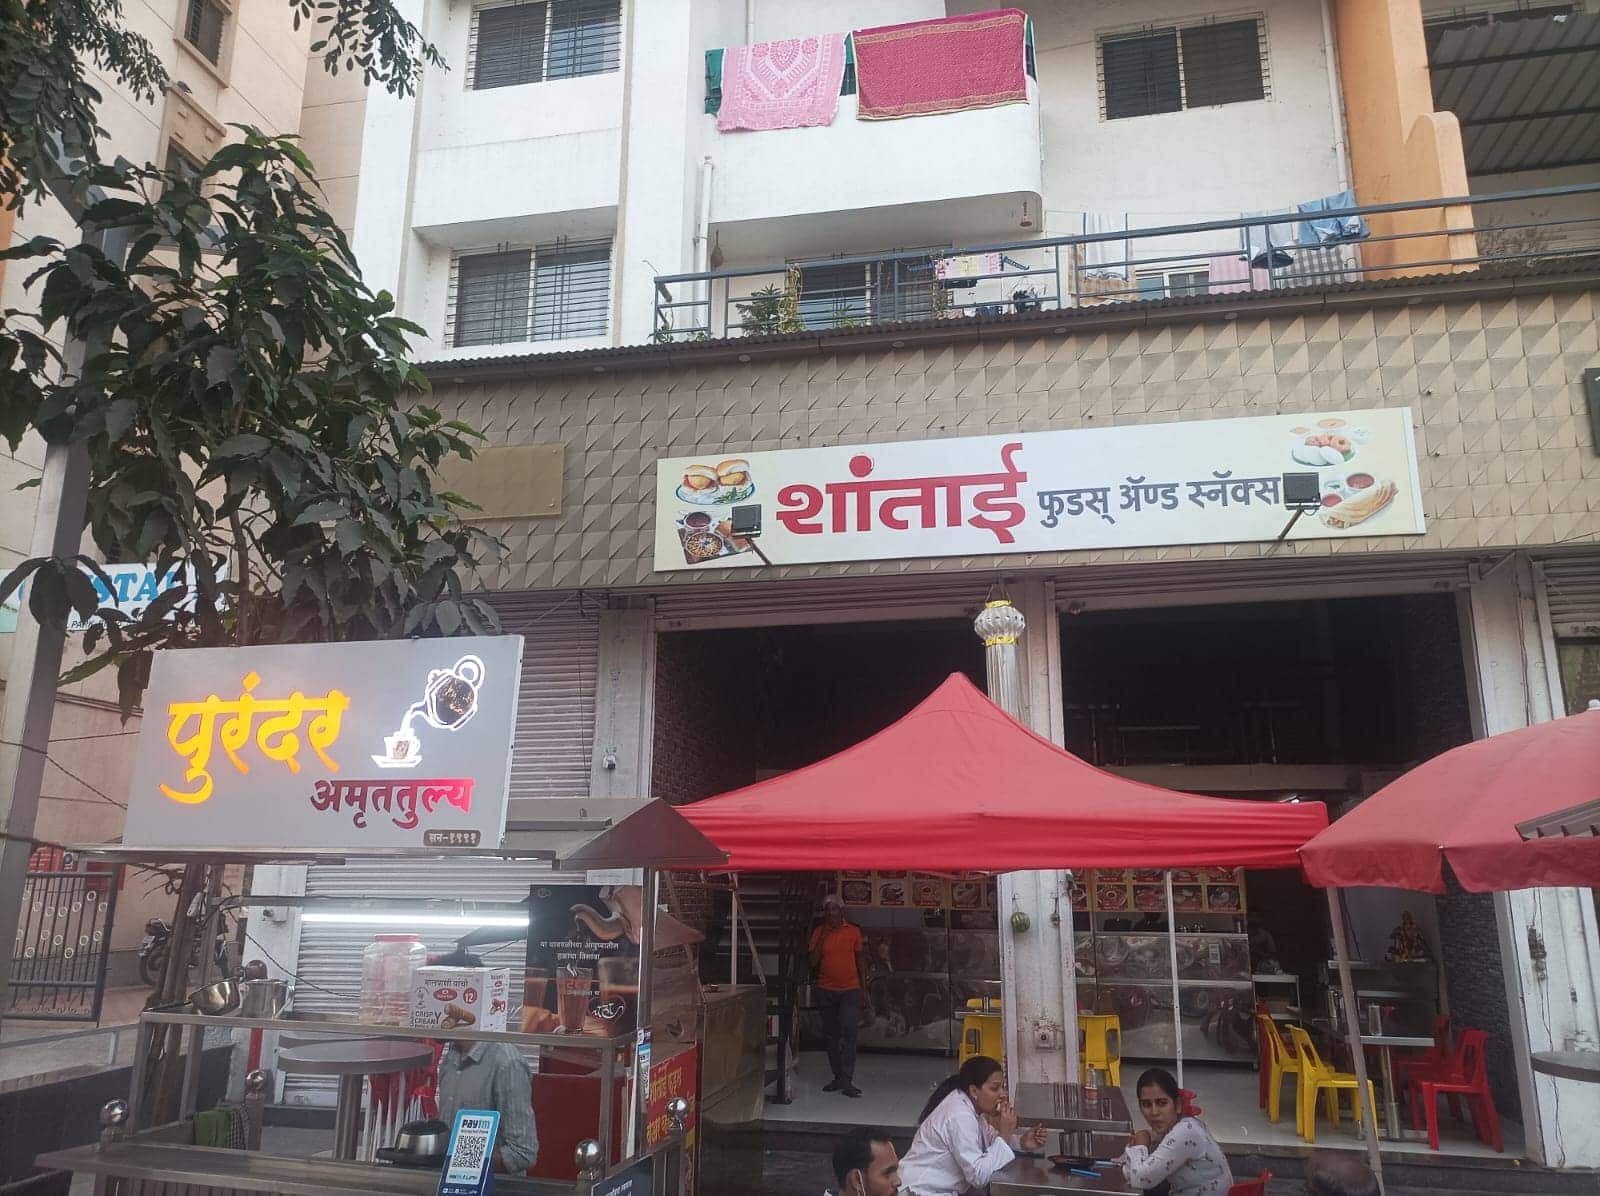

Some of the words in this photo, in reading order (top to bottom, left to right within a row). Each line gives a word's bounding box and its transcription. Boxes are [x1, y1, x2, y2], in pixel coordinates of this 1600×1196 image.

[776, 442, 1027, 544] शांताई
[158, 669, 352, 805] पुरंदर
[310, 777, 476, 830] अमृततुल्य
